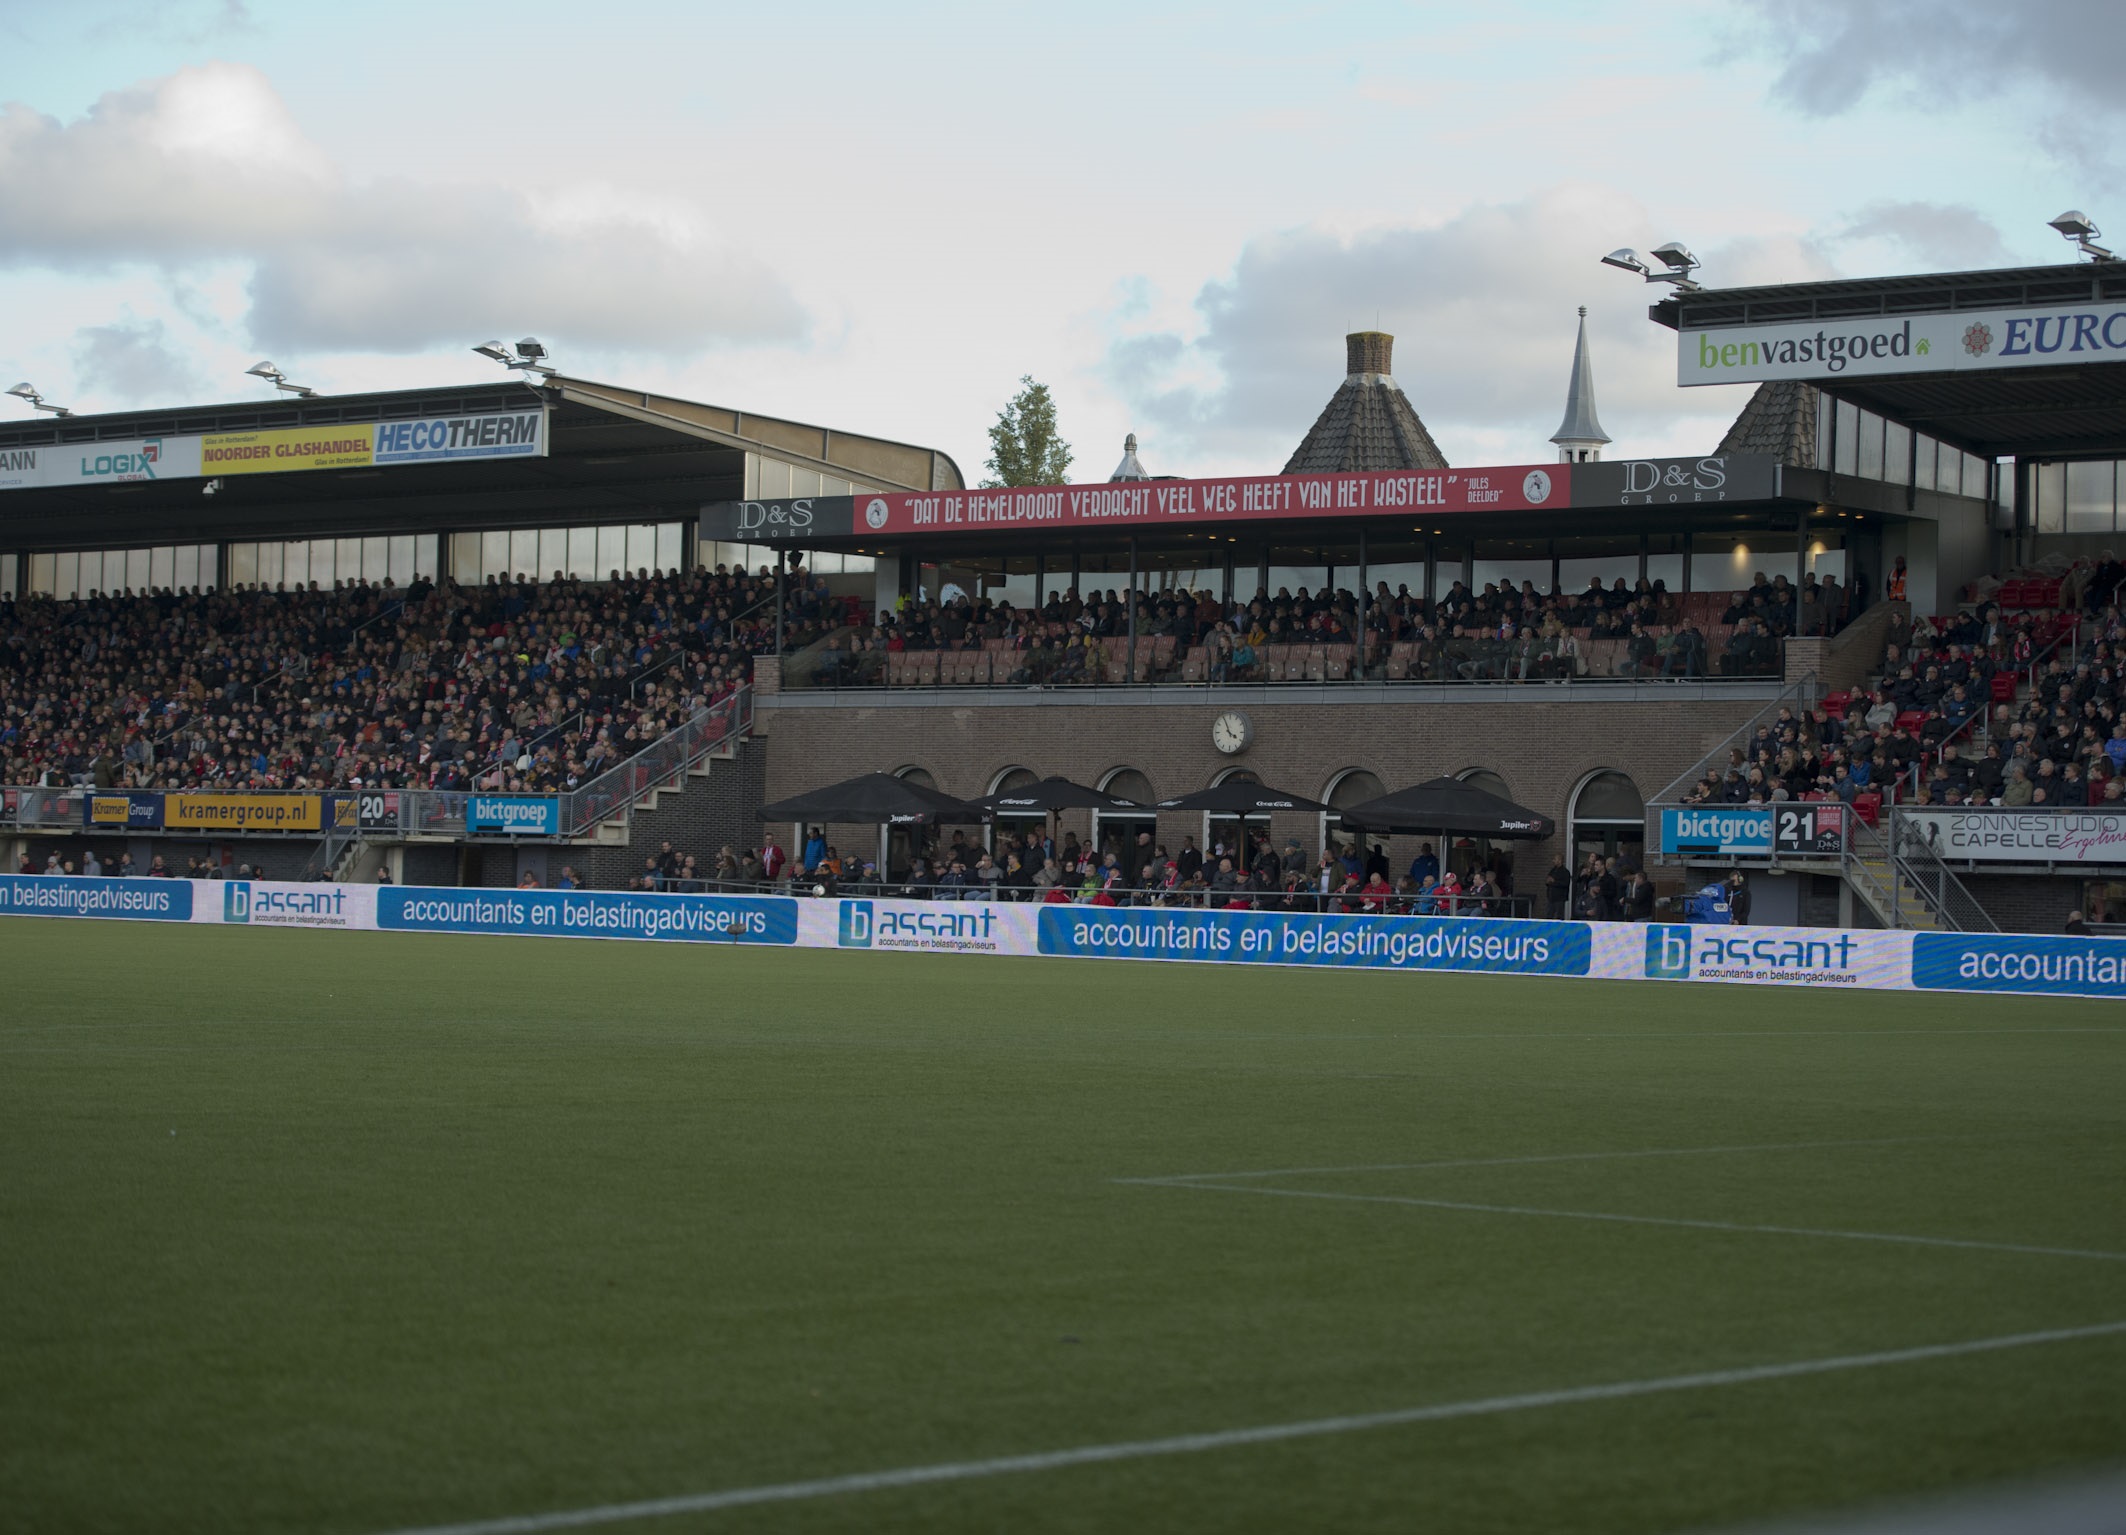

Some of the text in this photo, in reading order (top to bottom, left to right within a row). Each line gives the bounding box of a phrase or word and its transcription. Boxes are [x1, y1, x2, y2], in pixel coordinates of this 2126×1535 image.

[1700, 320, 1910, 372] benvastgoed
[377, 415, 538, 452] HECOTHERM
[204, 445, 271, 462] NOORDER
[275, 438, 370, 458] GLASHANDEL
[81, 453, 156, 479] LOGIX
[1621, 458, 1726, 493] D&S
[945, 497, 963, 523] DE
[968, 492, 1064, 522] HEMELPOORT
[1070, 488, 1150, 517] VERDACHT
[1156, 486, 1196, 514] VEEL
[1202, 484, 1236, 512] WEG
[1243, 482, 1291, 511] HEEFT
[1298, 481, 1331, 509] VAN
[1337, 479, 1368, 508] HET
[1621, 491, 1725, 504] GROEP
[737, 499, 813, 529] D&S
[736, 527, 813, 539] GROEP
[129, 803, 155, 819] Group
[179, 799, 306, 825] kramergroup.nl
[361, 796, 384, 819] 20
[476, 799, 547, 826] bictgroep
[890, 814, 914, 823] Jupiler
[1500, 820, 1530, 830] Jupiler
[1677, 811, 1772, 844] bictgroe
[1779, 811, 1813, 841] 21
[1951, 815, 2119, 832] ZONNESTUDIO
[1952, 833, 2060, 848] CAPELLE
[14, 882, 169, 914] belastingadviseurs
[403, 898, 766, 936] accountants en belastingadviseurs
[878, 938, 996, 950] accountants en belastingadviseurs
[1074, 920, 1549, 965] accountants en belastingadviseurs
[1699, 968, 1857, 983] accountants en belastingadviseurs
